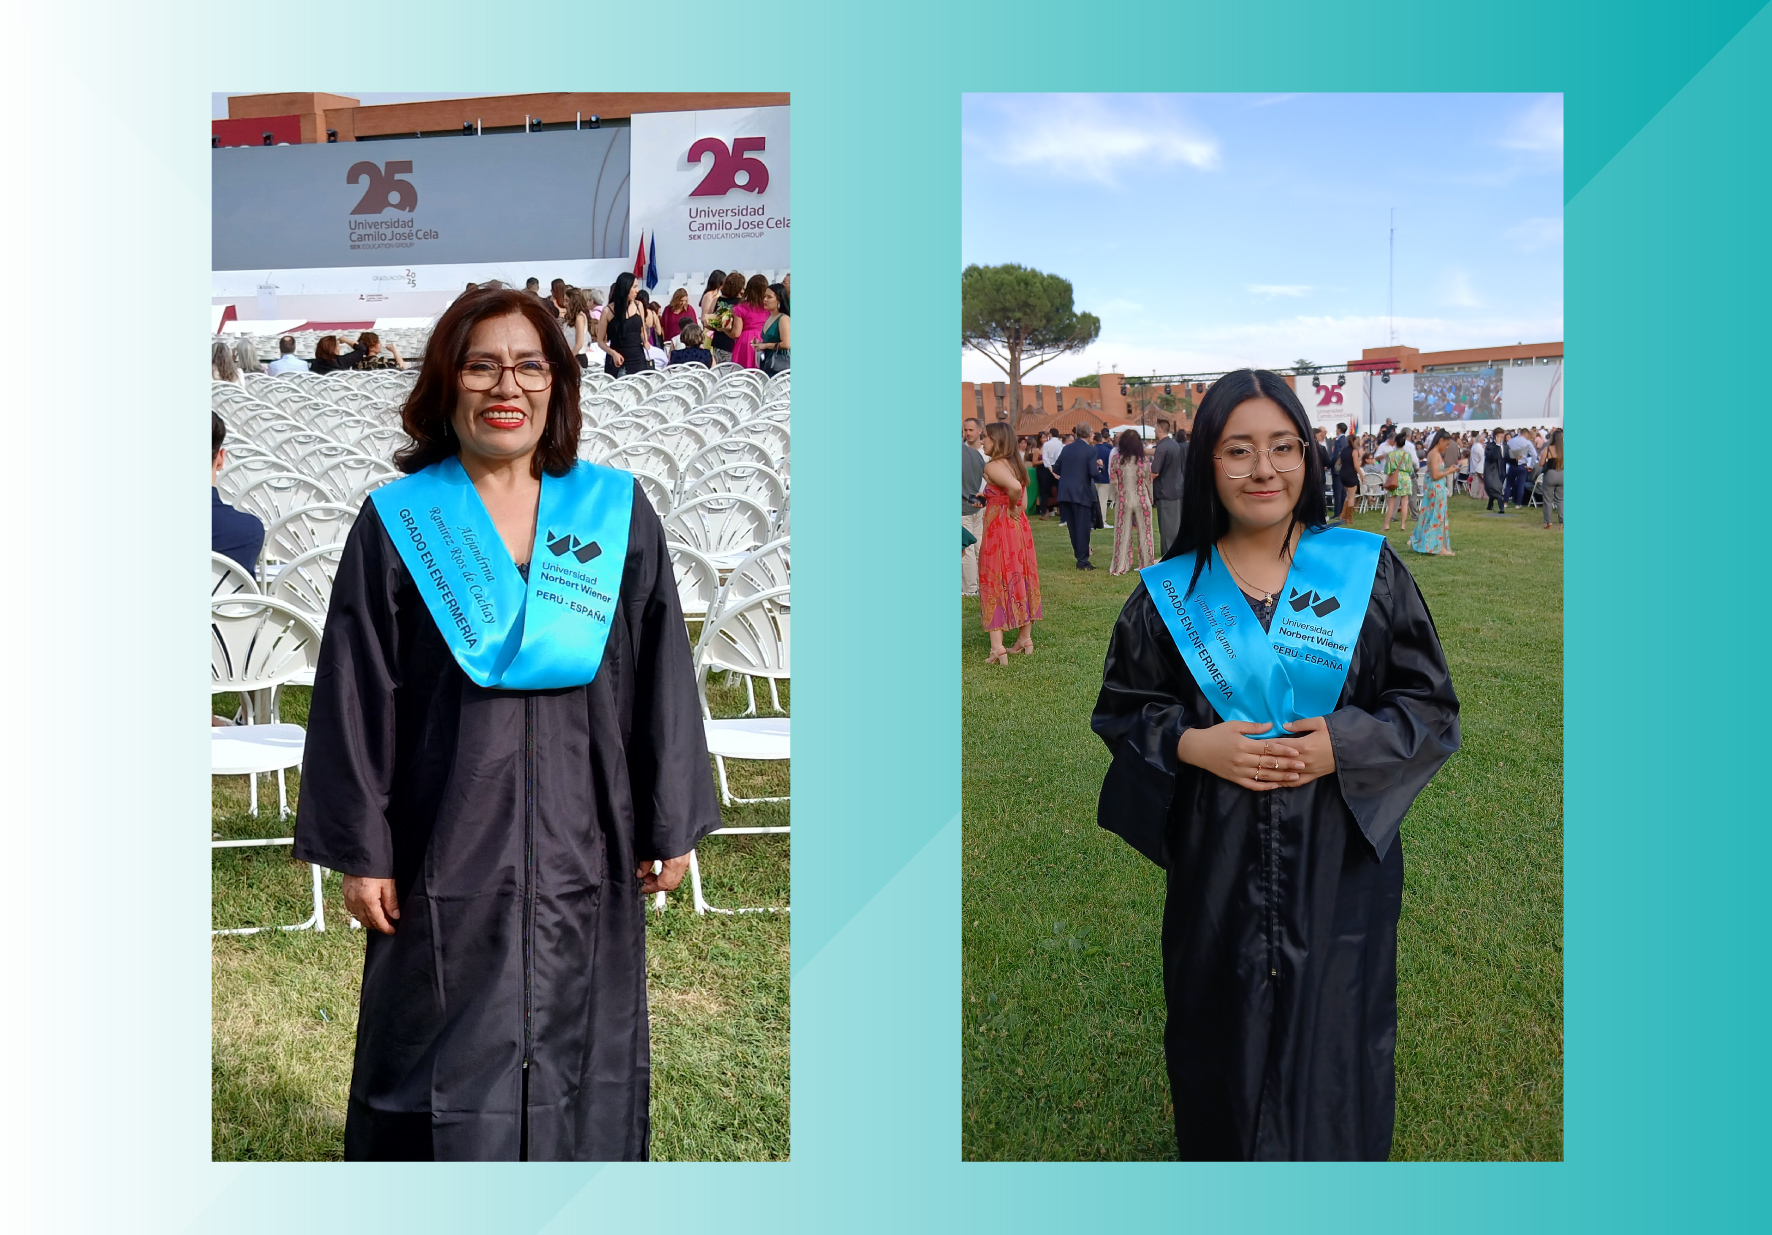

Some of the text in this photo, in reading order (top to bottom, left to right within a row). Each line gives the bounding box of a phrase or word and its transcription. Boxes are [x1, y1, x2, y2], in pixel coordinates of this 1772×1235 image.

[688, 137, 769, 197] 25
[346, 160, 418, 215] 25
[688, 204, 765, 219] Universidad
[348, 218, 414, 230] Universidad
[349, 228, 439, 243] Camilo José Cela
[688, 219, 733, 233] Camilo
[702, 232, 740, 240] EDUCATION
[741, 231, 765, 239] GROUP
[361, 242, 394, 250] EDUCATION
[457, 526, 496, 582] Alejandrina
[399, 508, 478, 649] GRADO EN ENFERMERÍA
[462, 570, 478, 583] de
[542, 561, 598, 585] Universidad
[540, 571, 612, 604] Norbert Wiener
[469, 584, 496, 624] Cachay
[536, 589, 564, 605] PERÚ
[569, 601, 607, 624] ESPAÑA
[1219, 603, 1238, 627] Ruby
[1193, 594, 1237, 660] Gambini Ramos
[1278, 626, 1349, 652] Norbert Wiener
[1282, 617, 1334, 637] Universidad
[1162, 579, 1234, 700] GRADO EN ENFERMERÍA
[1304, 653, 1343, 672] ESPAÑA
